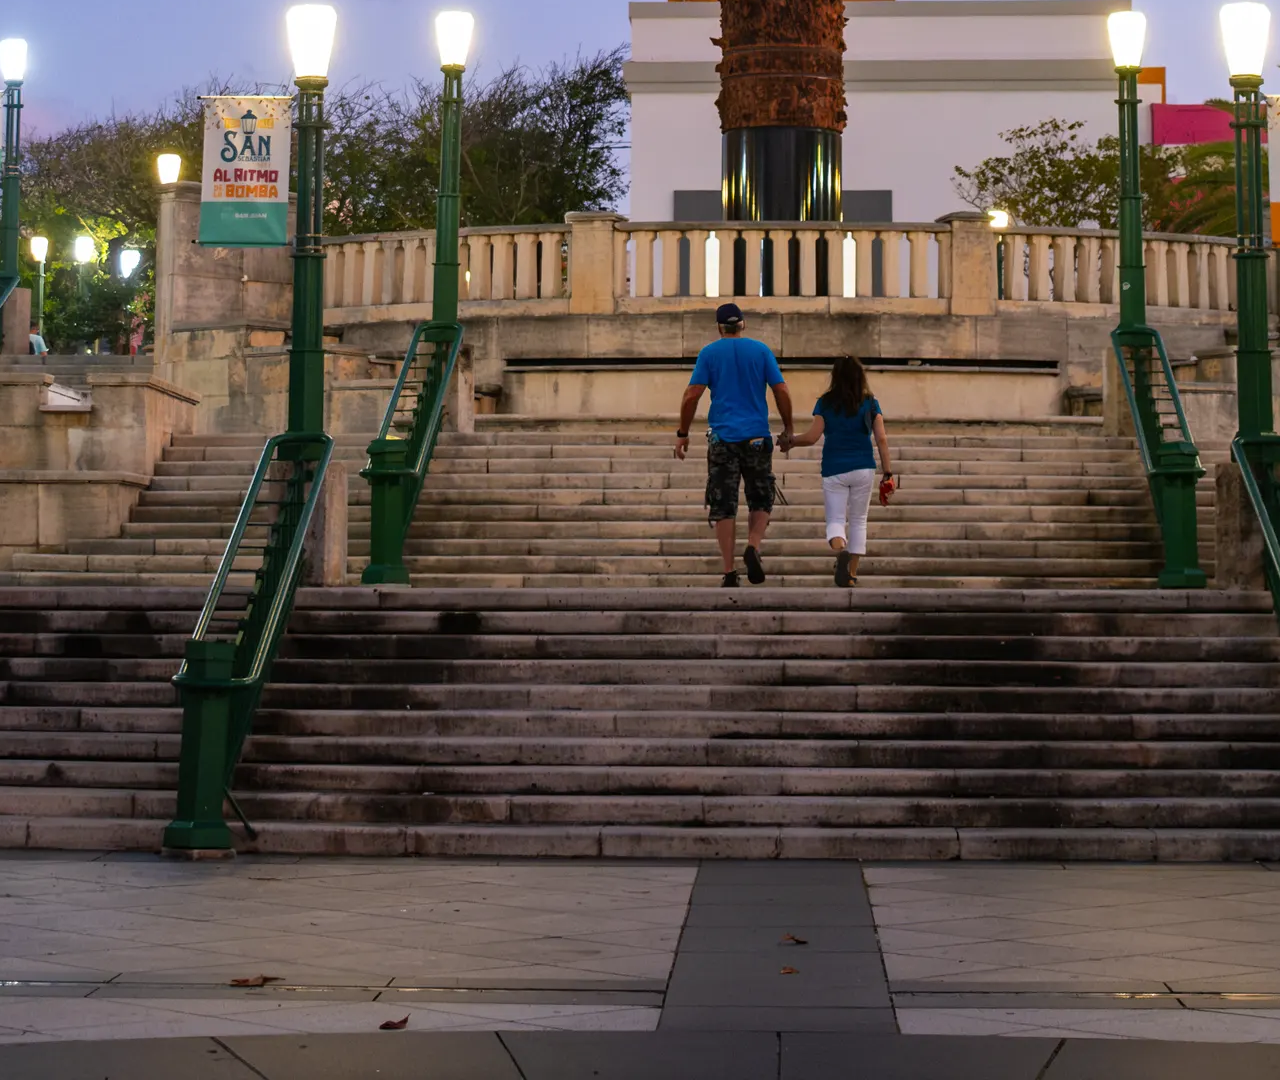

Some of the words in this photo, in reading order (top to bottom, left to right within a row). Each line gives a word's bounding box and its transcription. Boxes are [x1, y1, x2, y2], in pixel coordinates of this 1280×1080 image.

[220, 130, 271, 163] SAN
[213, 168, 231, 182] AL
[234, 168, 279, 183] RITMO
[225, 184, 278, 198] BOMBA
